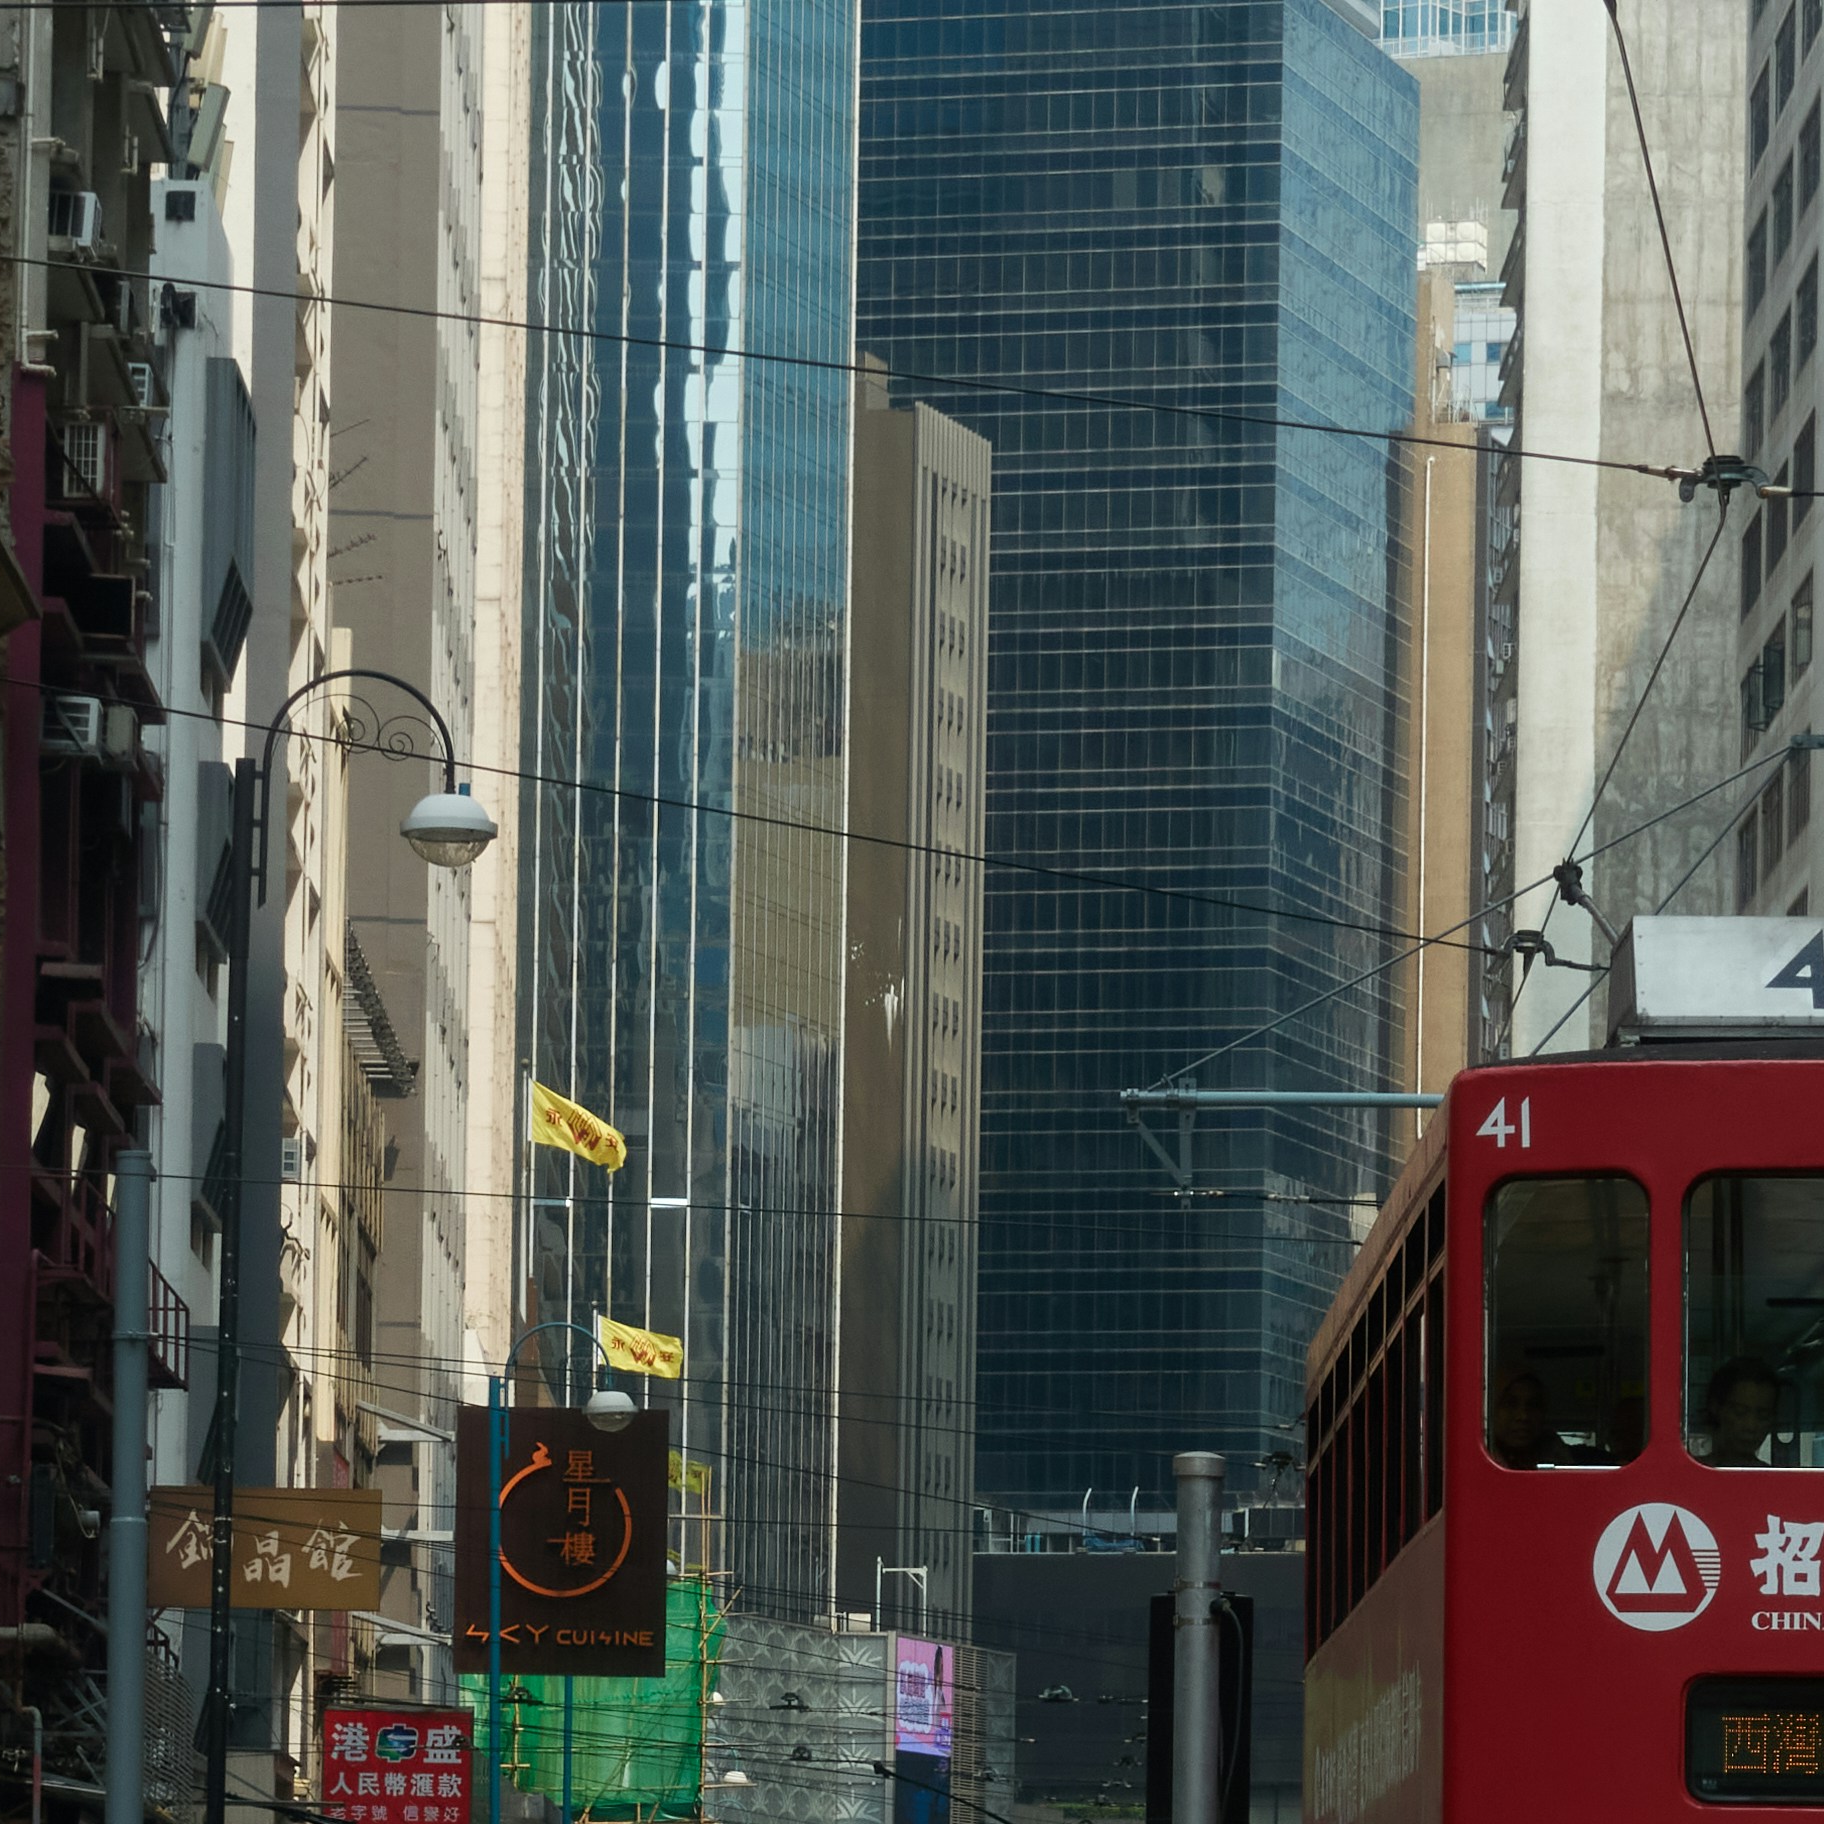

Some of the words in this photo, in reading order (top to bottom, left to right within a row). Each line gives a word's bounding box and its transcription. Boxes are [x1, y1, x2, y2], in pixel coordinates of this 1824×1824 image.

[1475, 1095, 1531, 1148] 41
[547, 1450, 611, 1566] 星月樓
[555, 1629, 654, 1647] CUISINE
